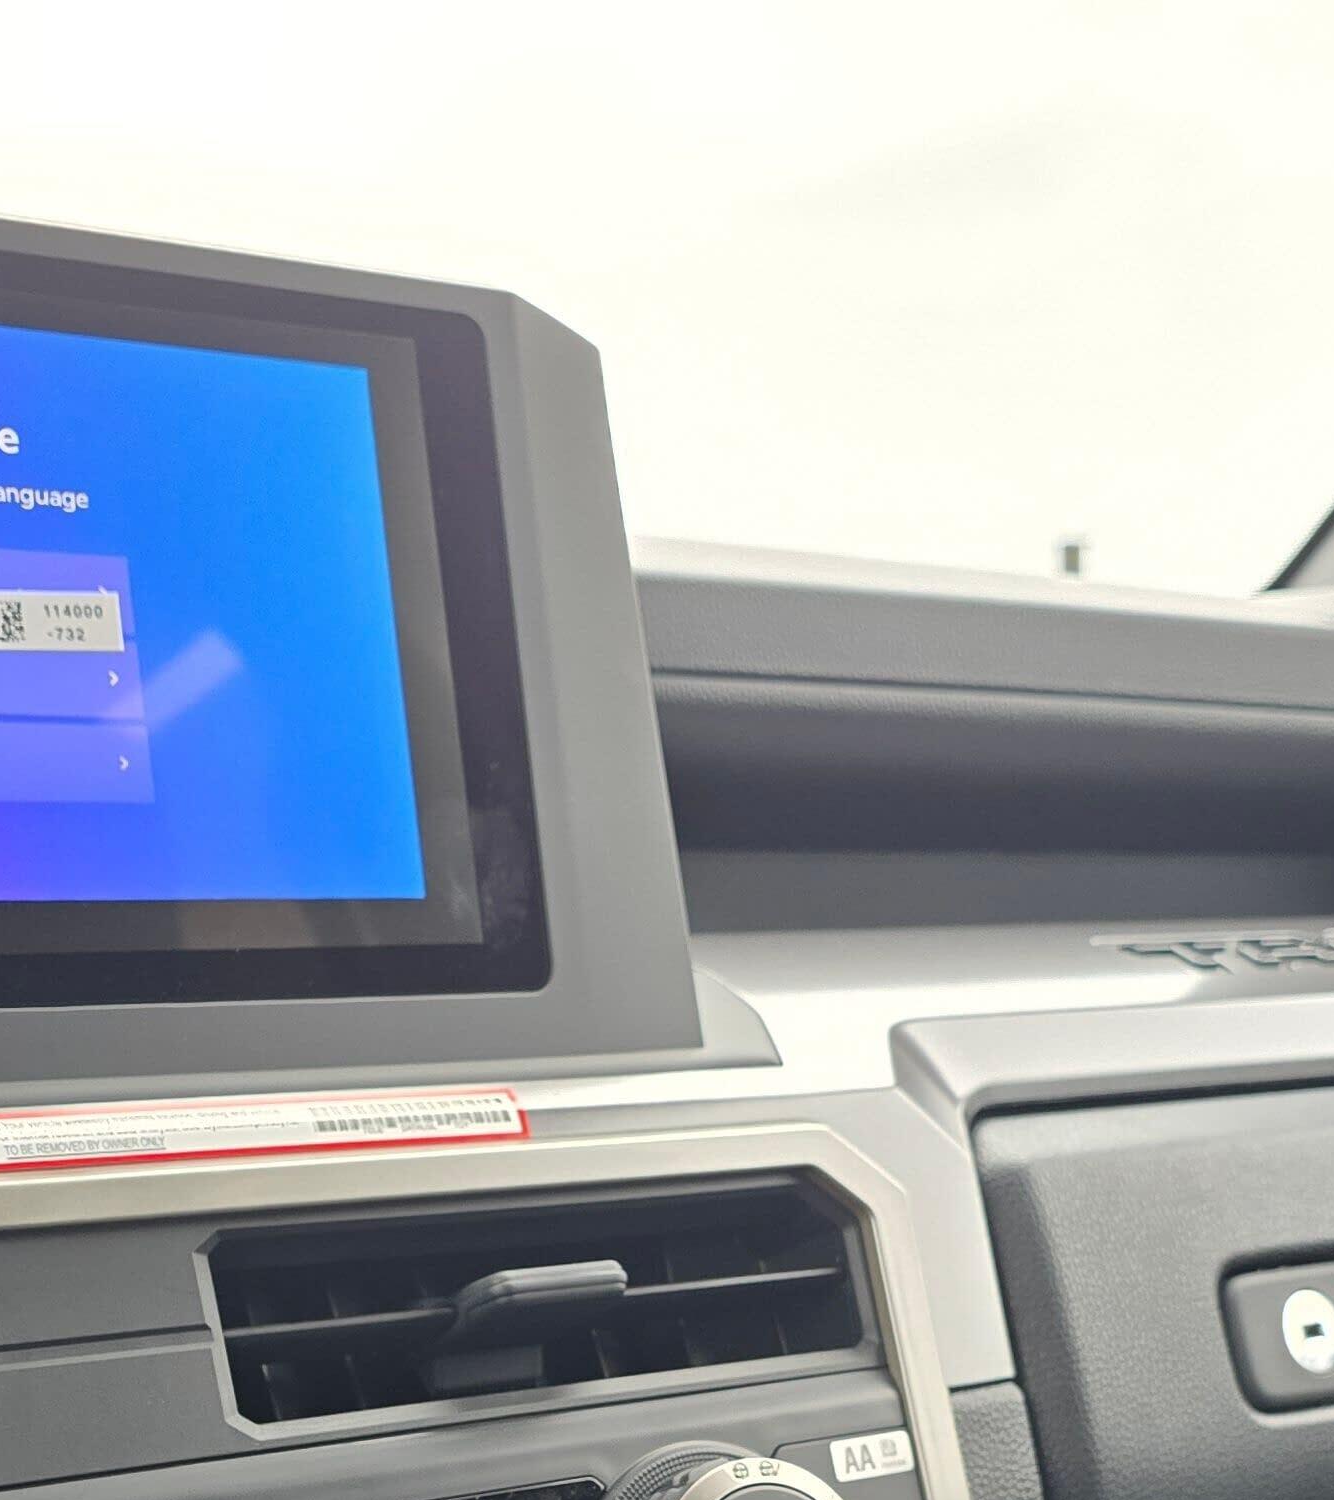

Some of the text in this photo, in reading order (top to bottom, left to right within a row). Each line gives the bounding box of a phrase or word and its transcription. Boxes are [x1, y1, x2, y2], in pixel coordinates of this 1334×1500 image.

[44, 604, 103, 619] 114000
[4, 1145, 19, 1156] TO
[20, 1143, 34, 1155] BE
[36, 1140, 86, 1153] REMOVED
[87, 1138, 100, 1150] BY
[102, 1137, 138, 1149] OWNER
[141, 1135, 165, 1147] ONLY
[845, 1444, 876, 1475] AA
